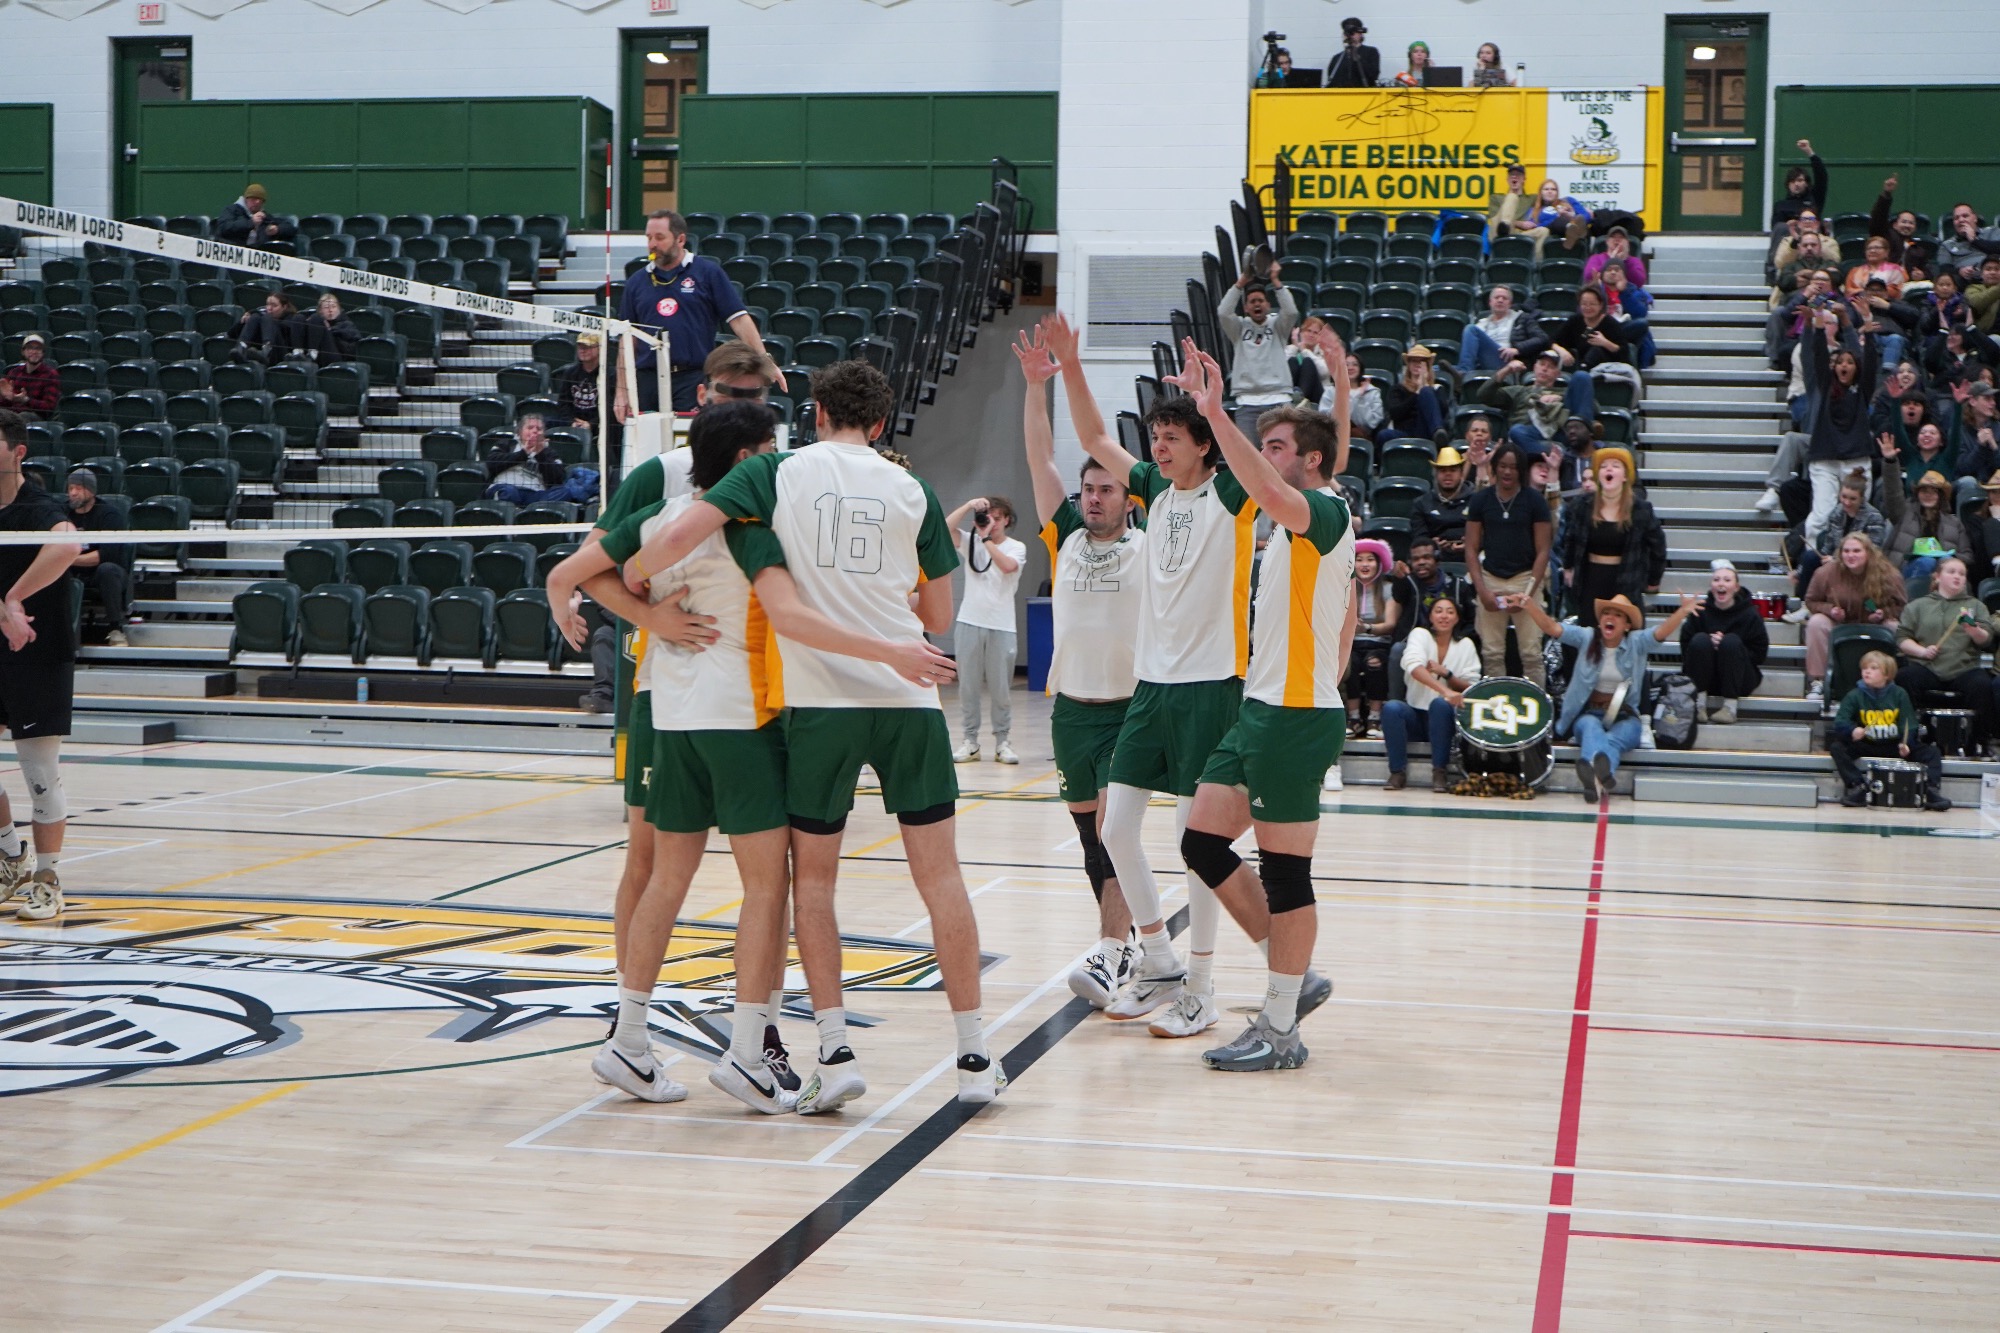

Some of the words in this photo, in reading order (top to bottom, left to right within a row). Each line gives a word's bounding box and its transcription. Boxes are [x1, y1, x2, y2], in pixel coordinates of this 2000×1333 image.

[140, 4, 159, 20] EXIT
[1562, 91, 1591, 101] VOICE
[1596, 91, 1608, 101] OF
[1613, 91, 1632, 101] THE
[1579, 104, 1613, 114] LORDS
[1280, 144, 1357, 168] KATE
[1366, 144, 1519, 168] BEIRNESS
[1376, 174, 1496, 199] GONDOL
[1582, 170, 1608, 180] KATE
[1570, 182, 1620, 193] BEIRNESS
[17, 203, 76, 232] DURHAM
[82, 216, 124, 241] LORDS
[196, 240, 243, 265] DURHAM
[248, 250, 281, 271] LORDS
[340, 269, 378, 290] DURHAM
[382, 276, 409, 295] LORDS
[814, 492, 886, 575] 16
[1073, 551, 1121, 592] 12
